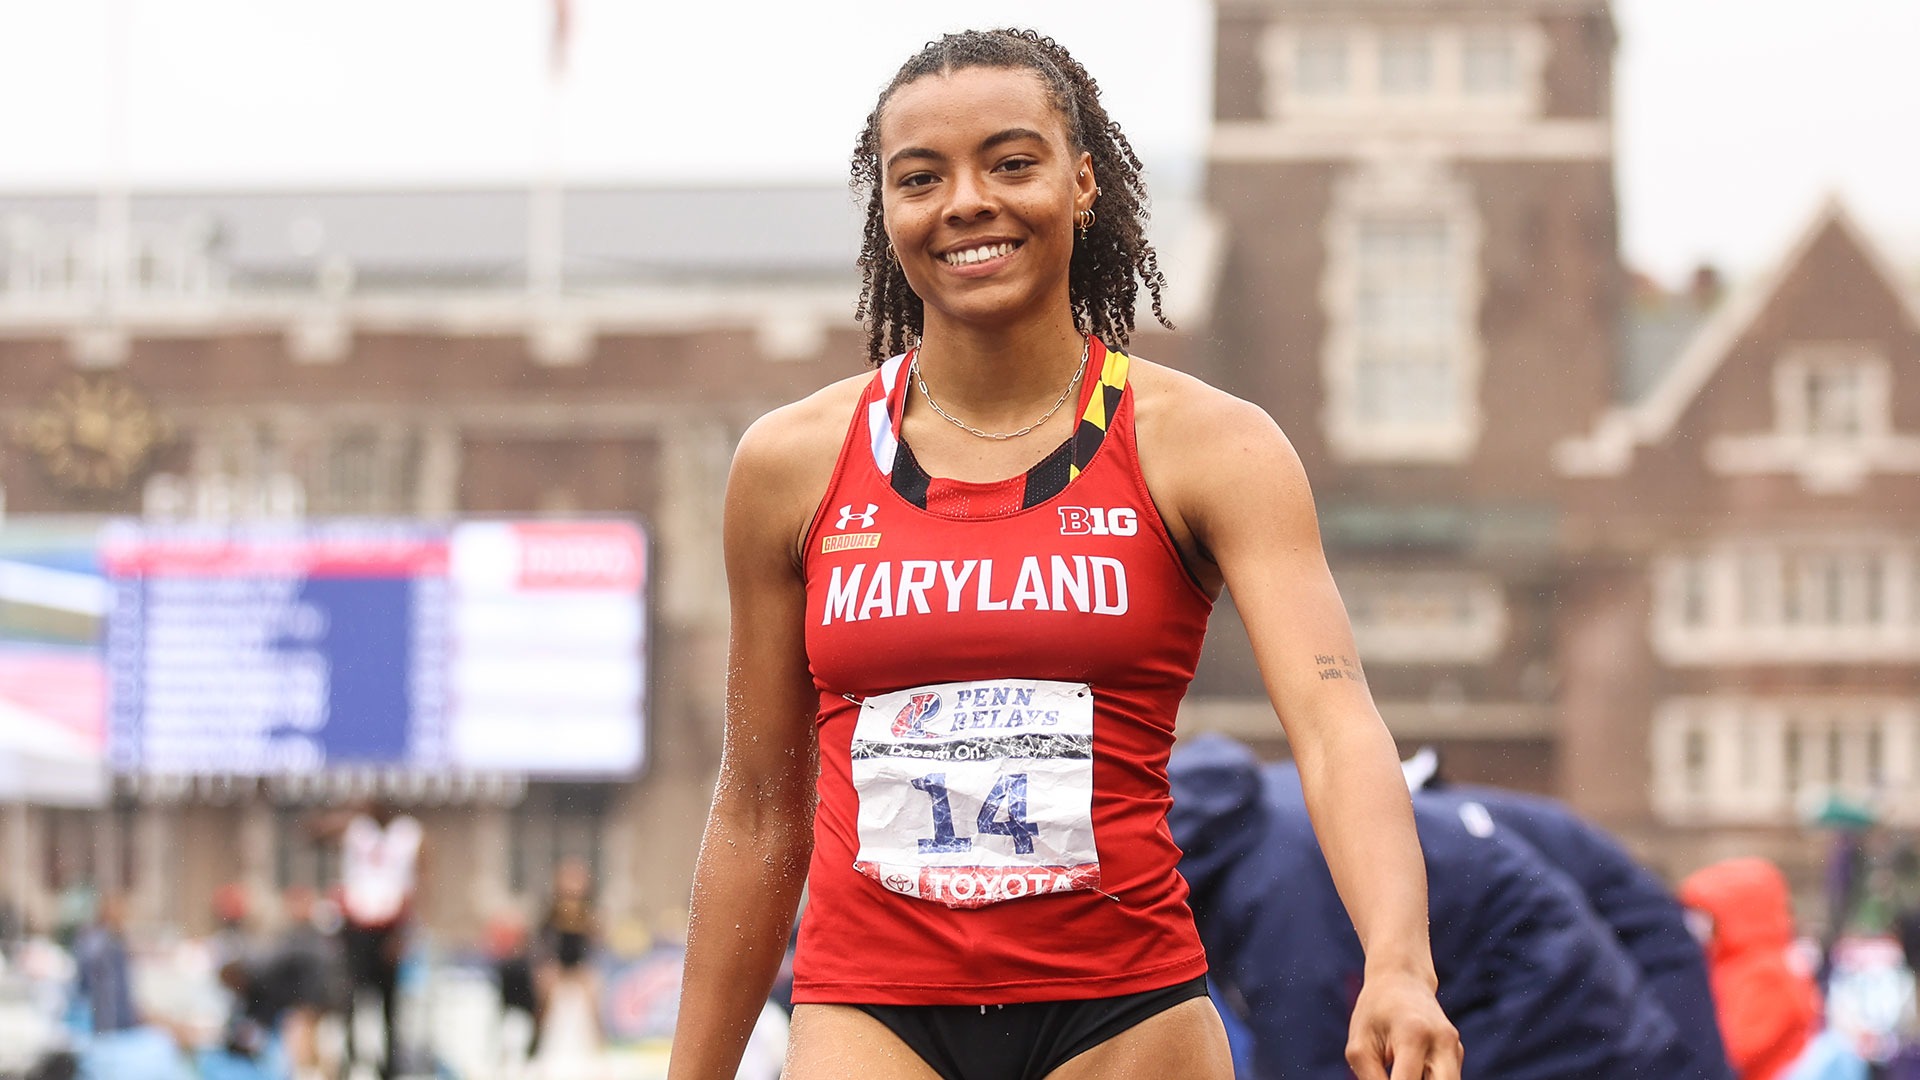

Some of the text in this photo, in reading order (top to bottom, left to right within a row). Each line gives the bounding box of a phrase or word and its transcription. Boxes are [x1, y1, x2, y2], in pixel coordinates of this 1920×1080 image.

[823, 534, 878, 552] GRADUATE
[822, 556, 1128, 626] MARYLAND
[1314, 654, 1336, 665] HOW
[1318, 668, 1343, 681] WHEN
[955, 688, 1036, 709] PENN
[950, 709, 1060, 732] RELAYS
[889, 745, 950, 760] Dream
[911, 772, 1038, 854] 14
[929, 873, 1074, 899] TOYOTA
